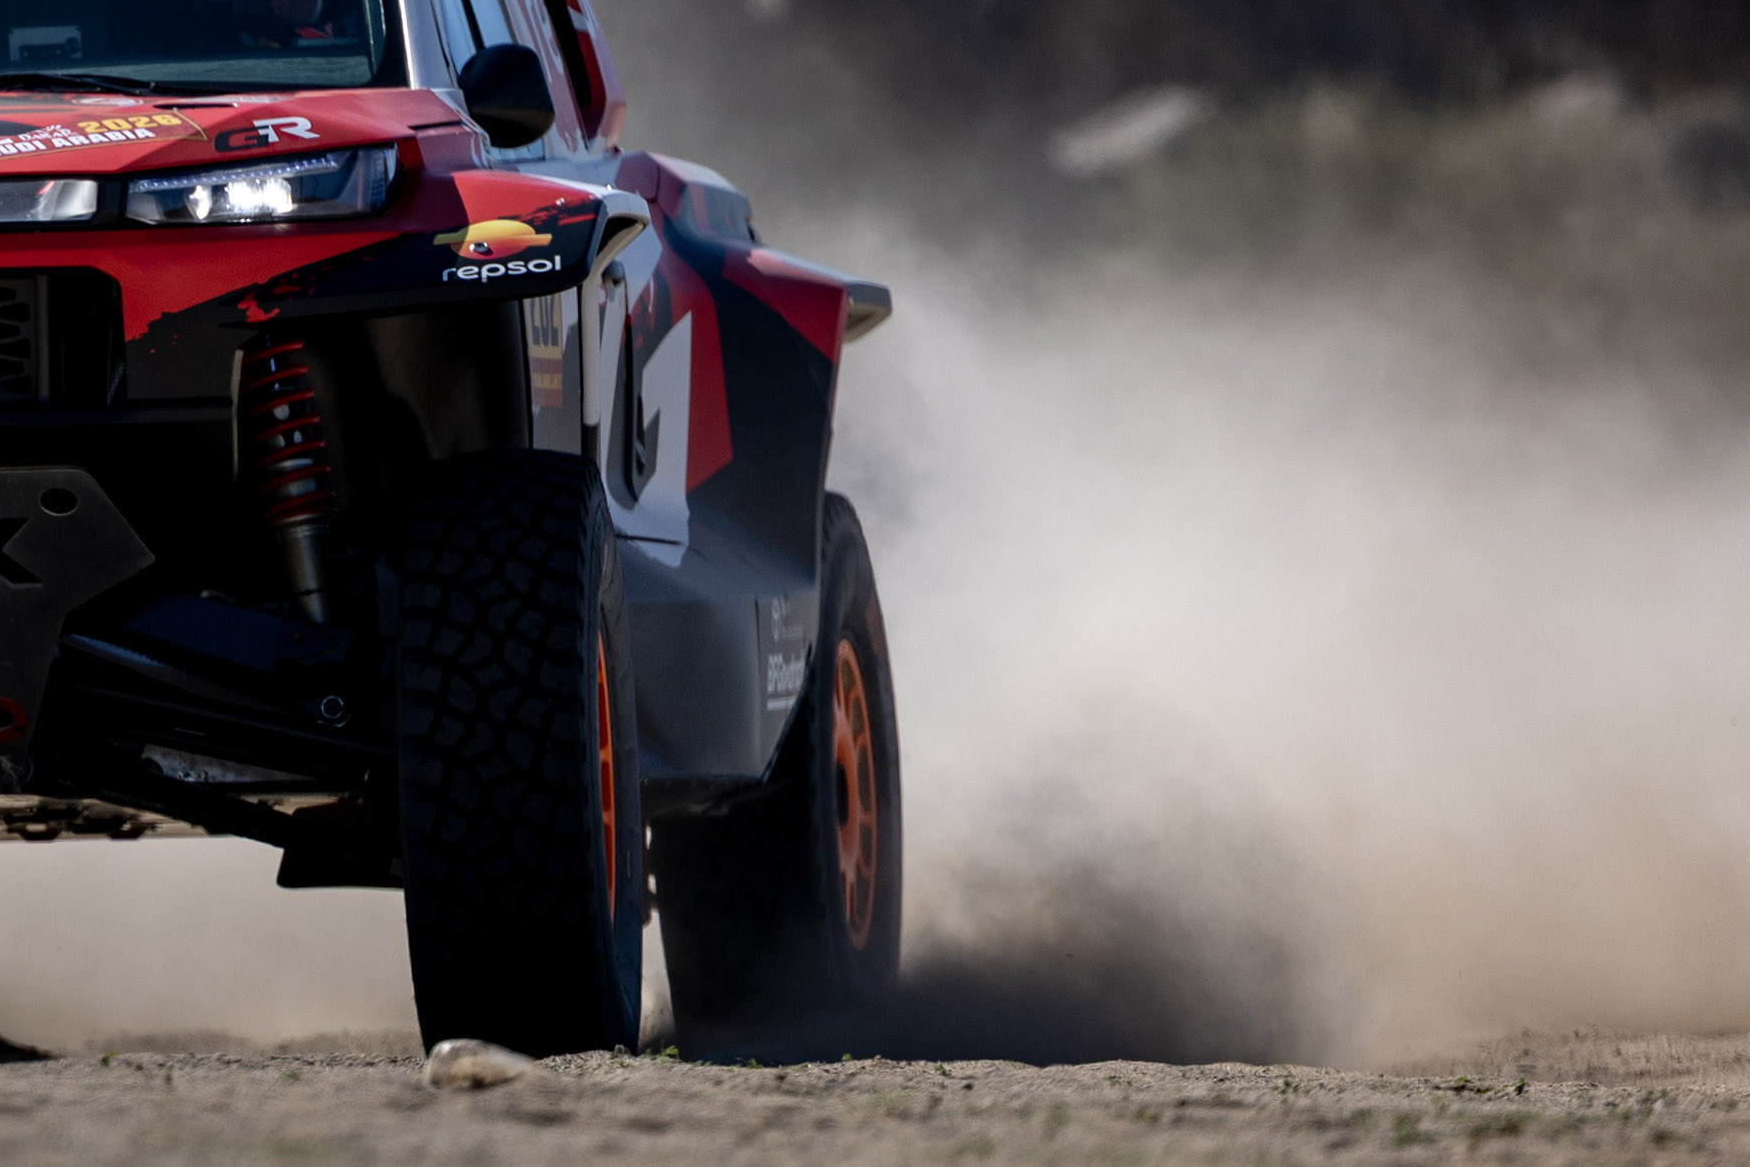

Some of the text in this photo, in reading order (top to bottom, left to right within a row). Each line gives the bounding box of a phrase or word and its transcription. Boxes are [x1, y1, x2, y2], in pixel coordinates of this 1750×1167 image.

[77, 113, 183, 134] 2026
[214, 116, 321, 152] GR
[52, 128, 156, 149] ARABIA
[442, 254, 562, 283] repsol
